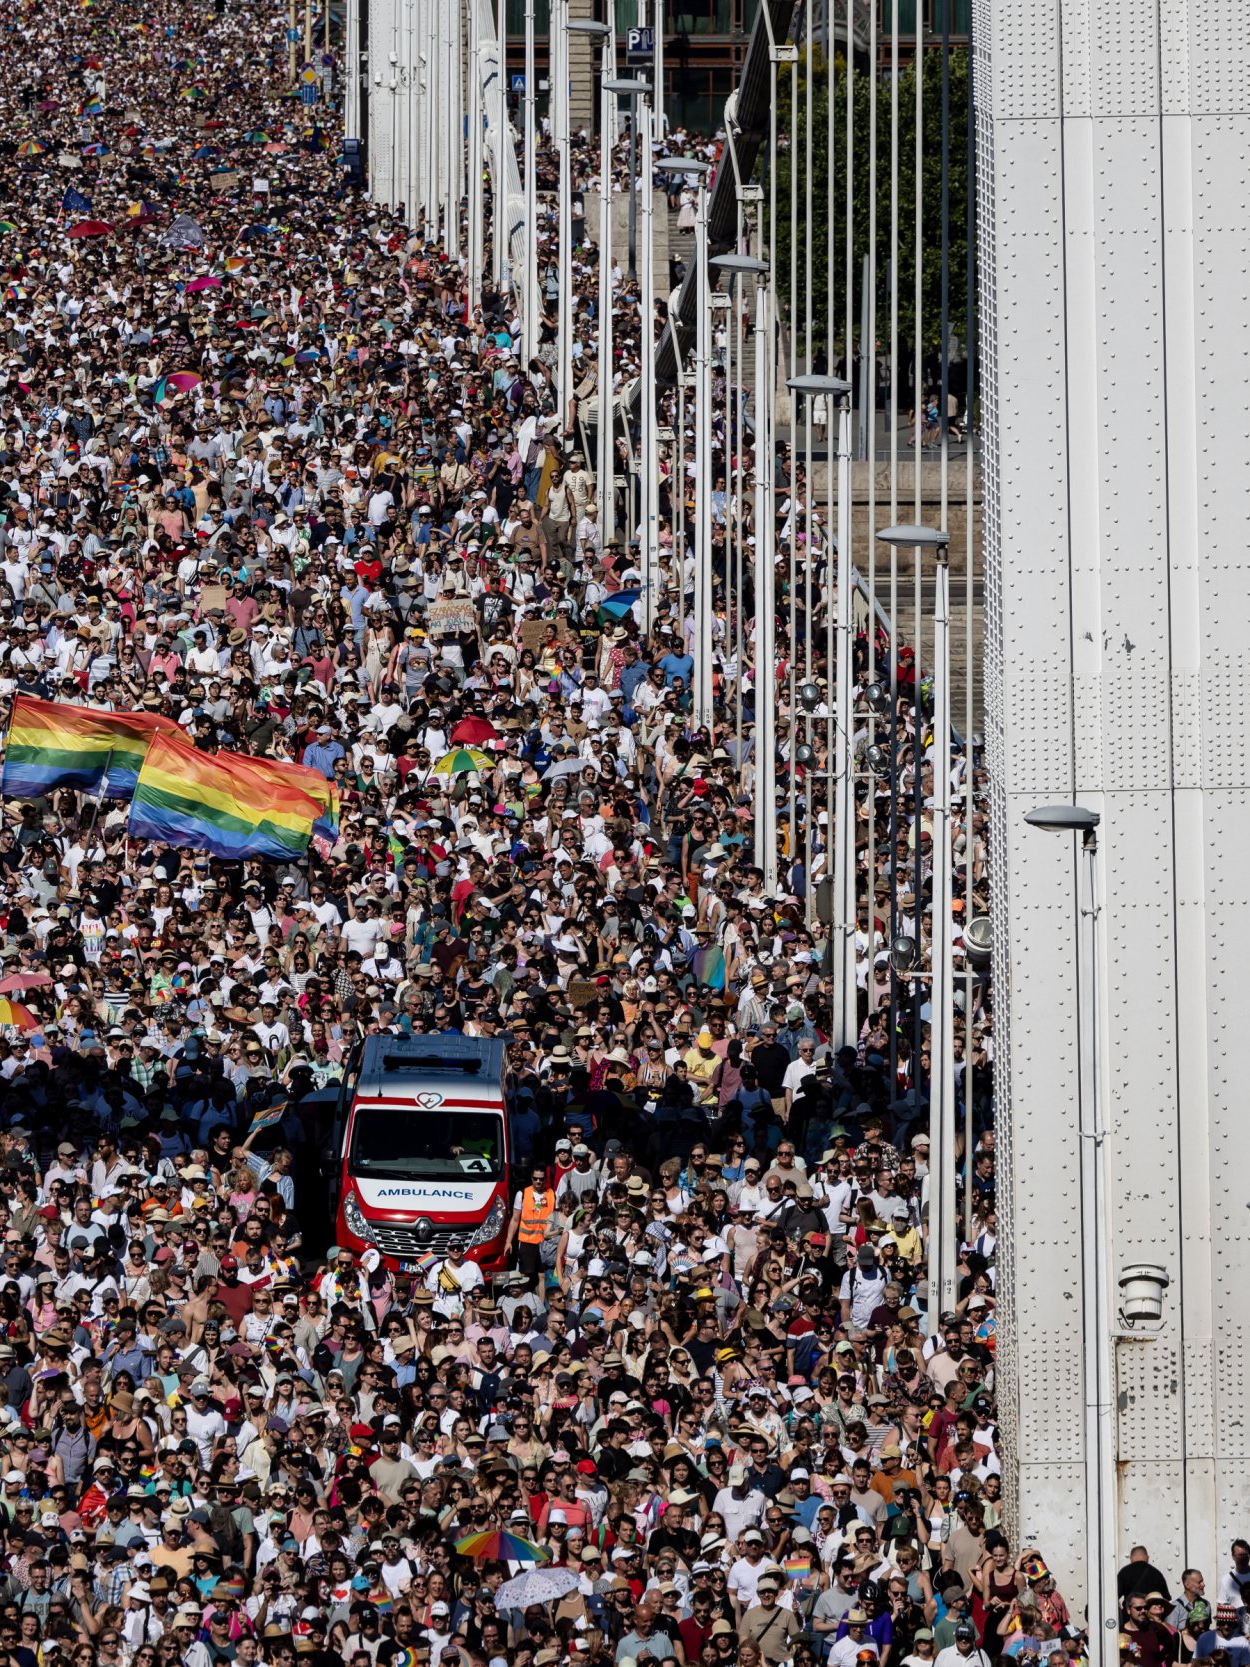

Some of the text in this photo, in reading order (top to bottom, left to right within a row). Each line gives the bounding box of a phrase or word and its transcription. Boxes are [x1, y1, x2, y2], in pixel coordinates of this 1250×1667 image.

[629, 32, 640, 50] P
[466, 1160, 487, 1172] 4
[377, 1188, 474, 1201] AMBULANCE
